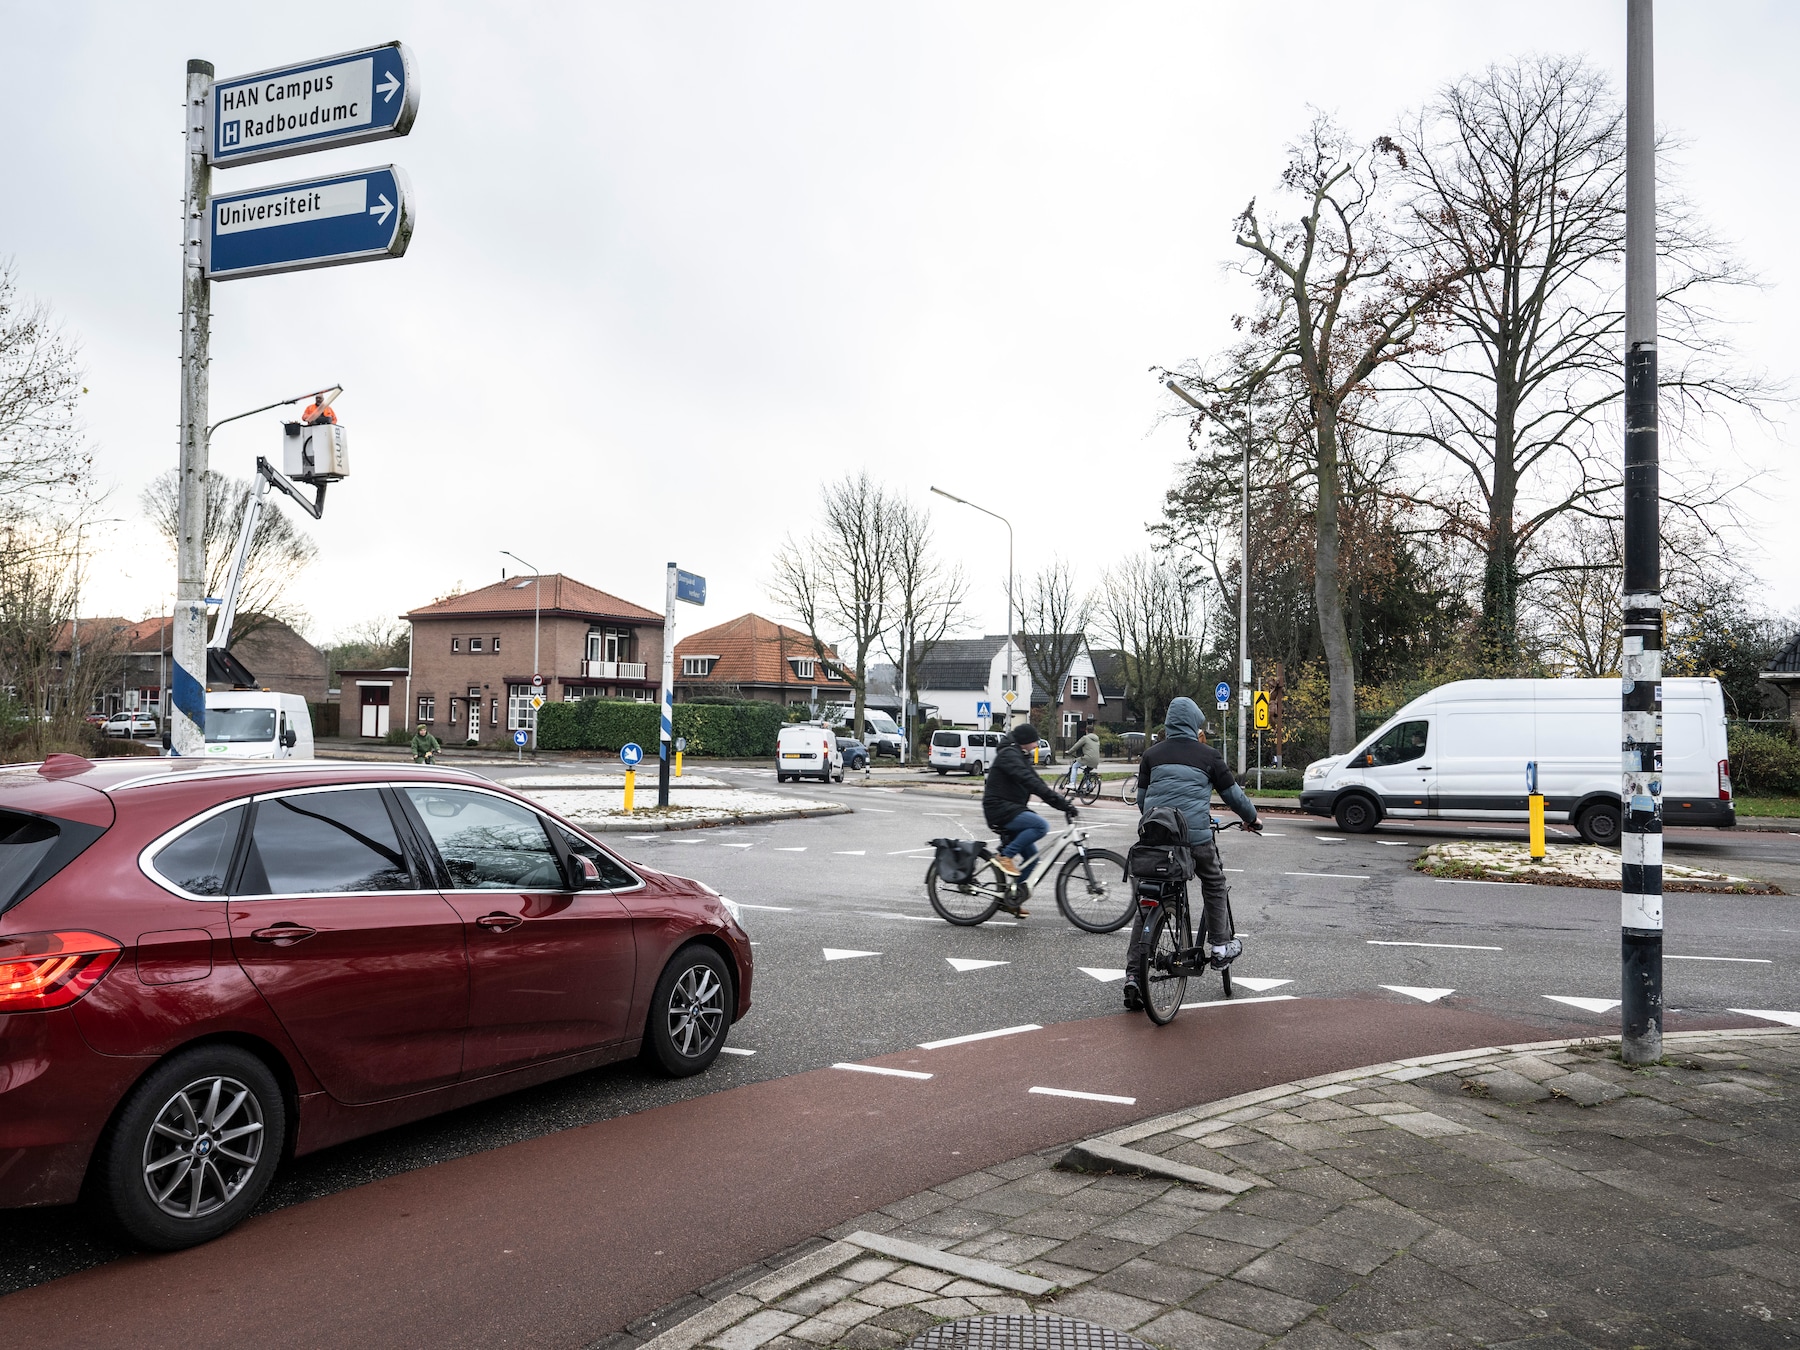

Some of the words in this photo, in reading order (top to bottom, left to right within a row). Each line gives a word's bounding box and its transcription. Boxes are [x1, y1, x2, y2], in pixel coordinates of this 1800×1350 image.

[224, 87, 259, 111] HAN
[265, 75, 333, 103] Campus
[245, 102, 359, 138] Radboudumc
[220, 193, 321, 226] Universiteit
[1259, 709, 1265, 720] G
